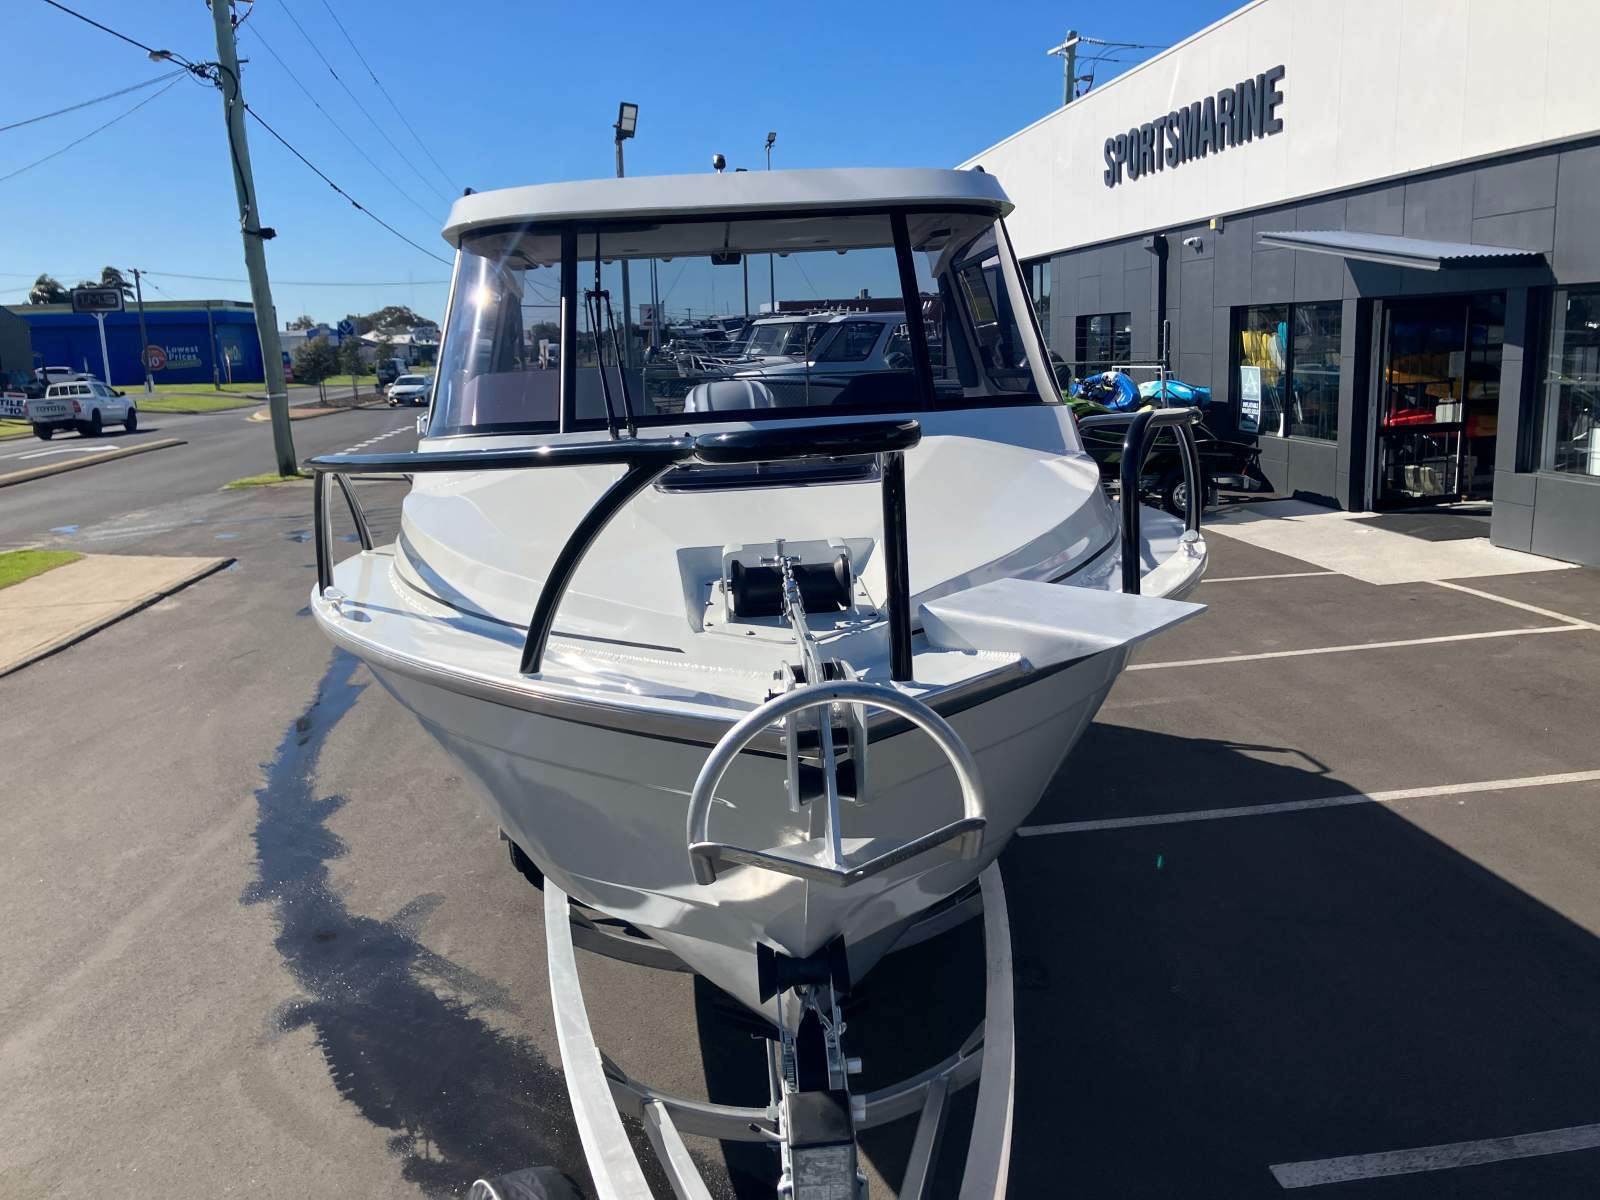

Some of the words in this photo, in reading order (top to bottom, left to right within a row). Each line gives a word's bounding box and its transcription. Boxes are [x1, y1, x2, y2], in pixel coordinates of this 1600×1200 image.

[1103, 64, 1285, 188] SPORTSMARINE
[166, 345, 199, 353] Lowest
[168, 351, 197, 360] Prices
